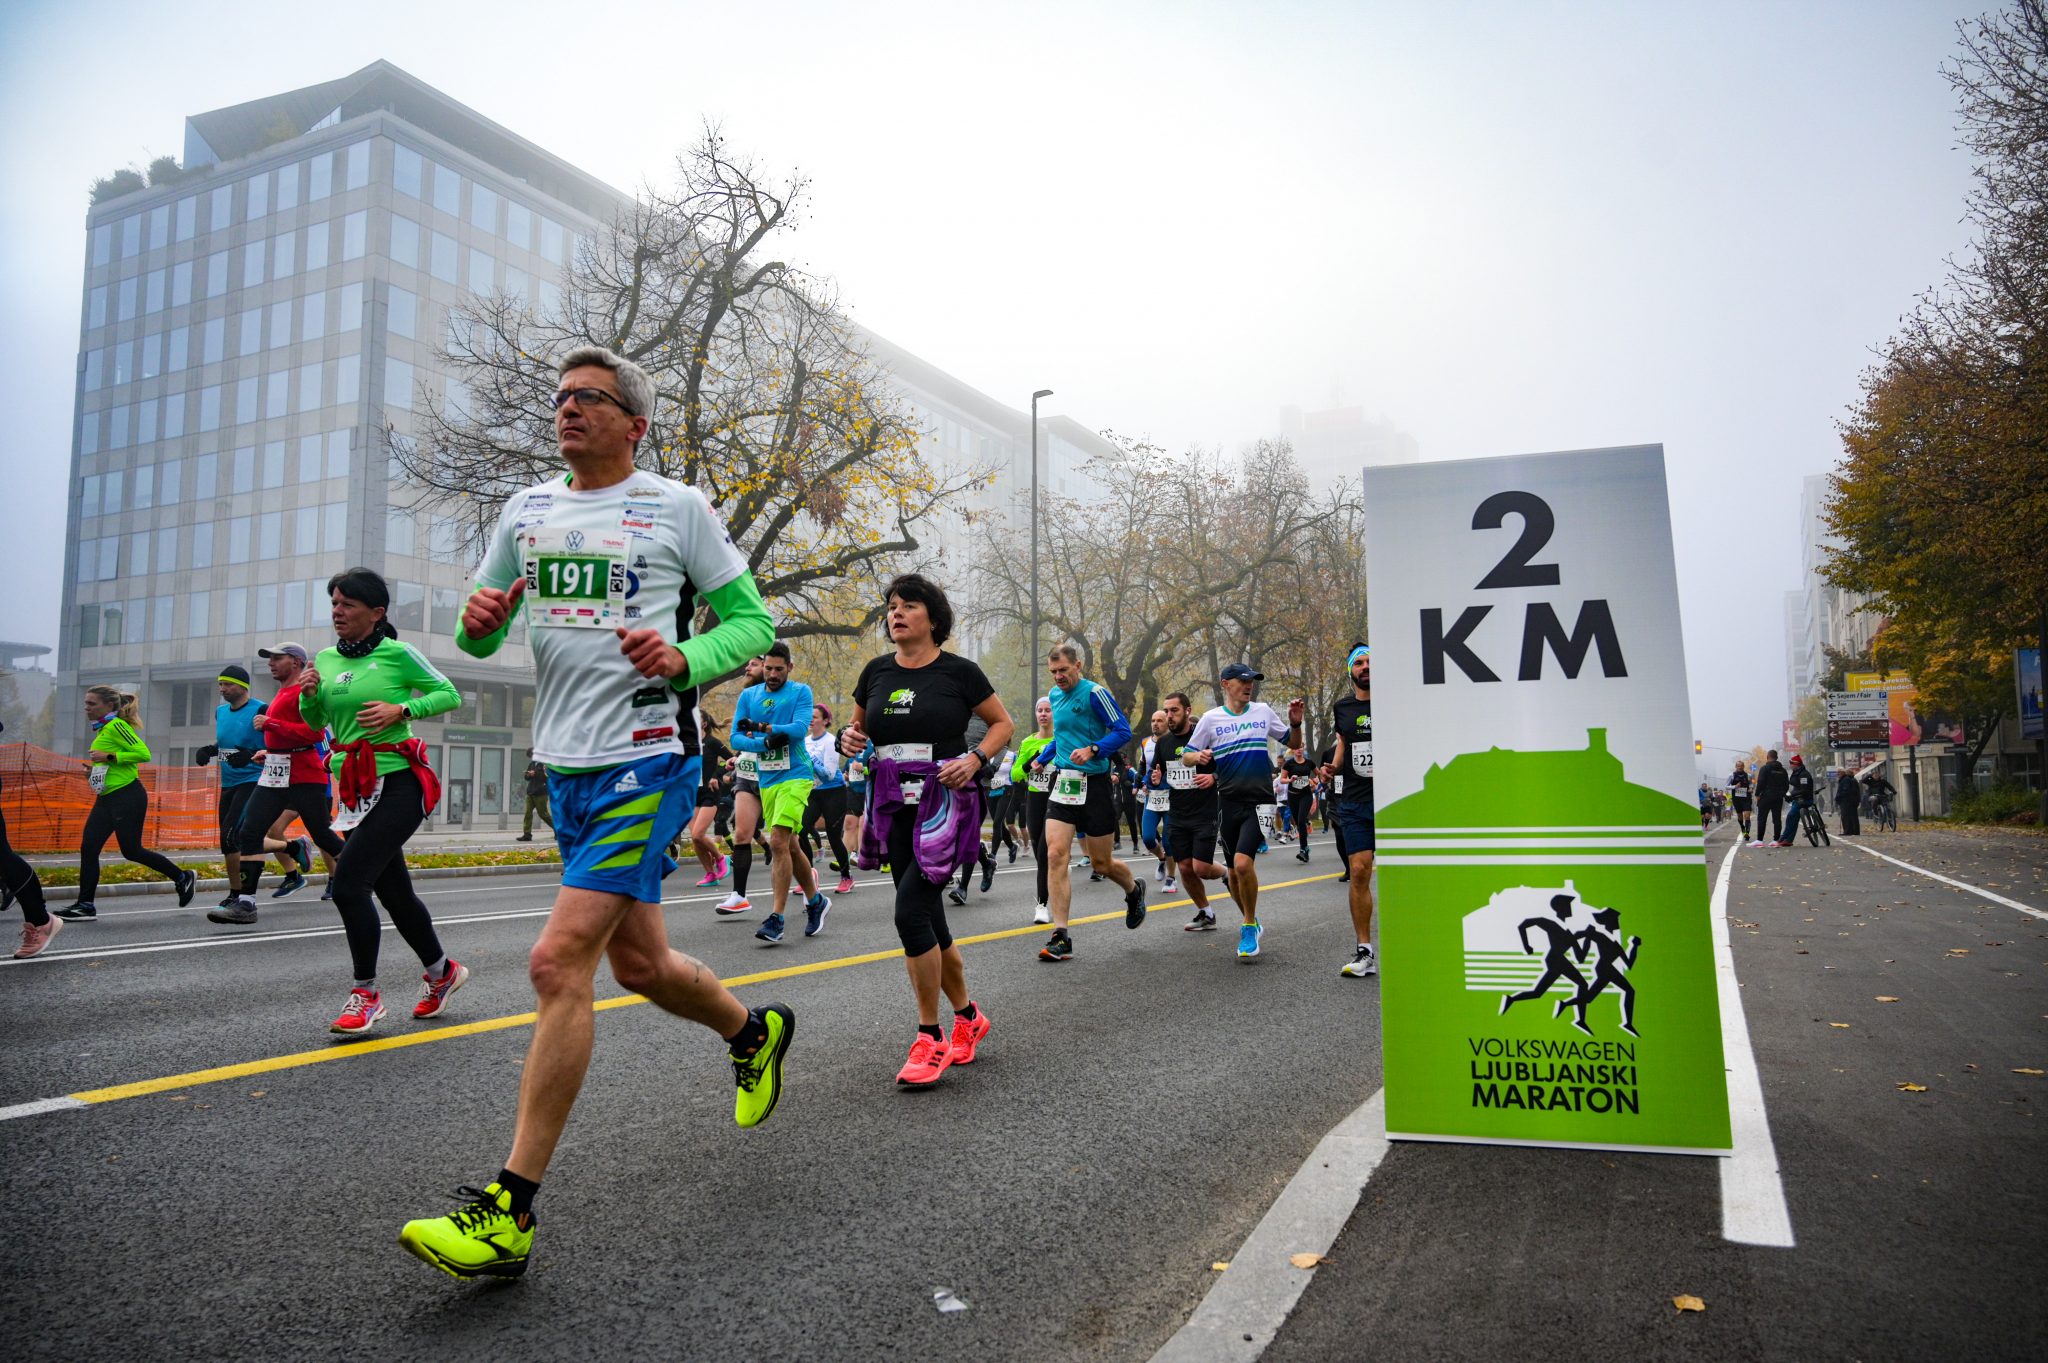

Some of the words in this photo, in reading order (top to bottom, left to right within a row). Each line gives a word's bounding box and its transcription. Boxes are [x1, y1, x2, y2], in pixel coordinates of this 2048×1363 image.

[1471, 490, 1561, 590] 2
[549, 562, 595, 595] 191
[1419, 598, 1629, 685] KM
[740, 760, 754, 772] 653
[1034, 773, 1049, 783] 285
[1172, 770, 1190, 780] 2111
[1065, 781, 1071, 793] 6
[1469, 1037, 1636, 1062] VOLKSWAGEN
[1471, 1060, 1638, 1086] LJUBLJANSKI
[1472, 1082, 1640, 1115] MARATON
